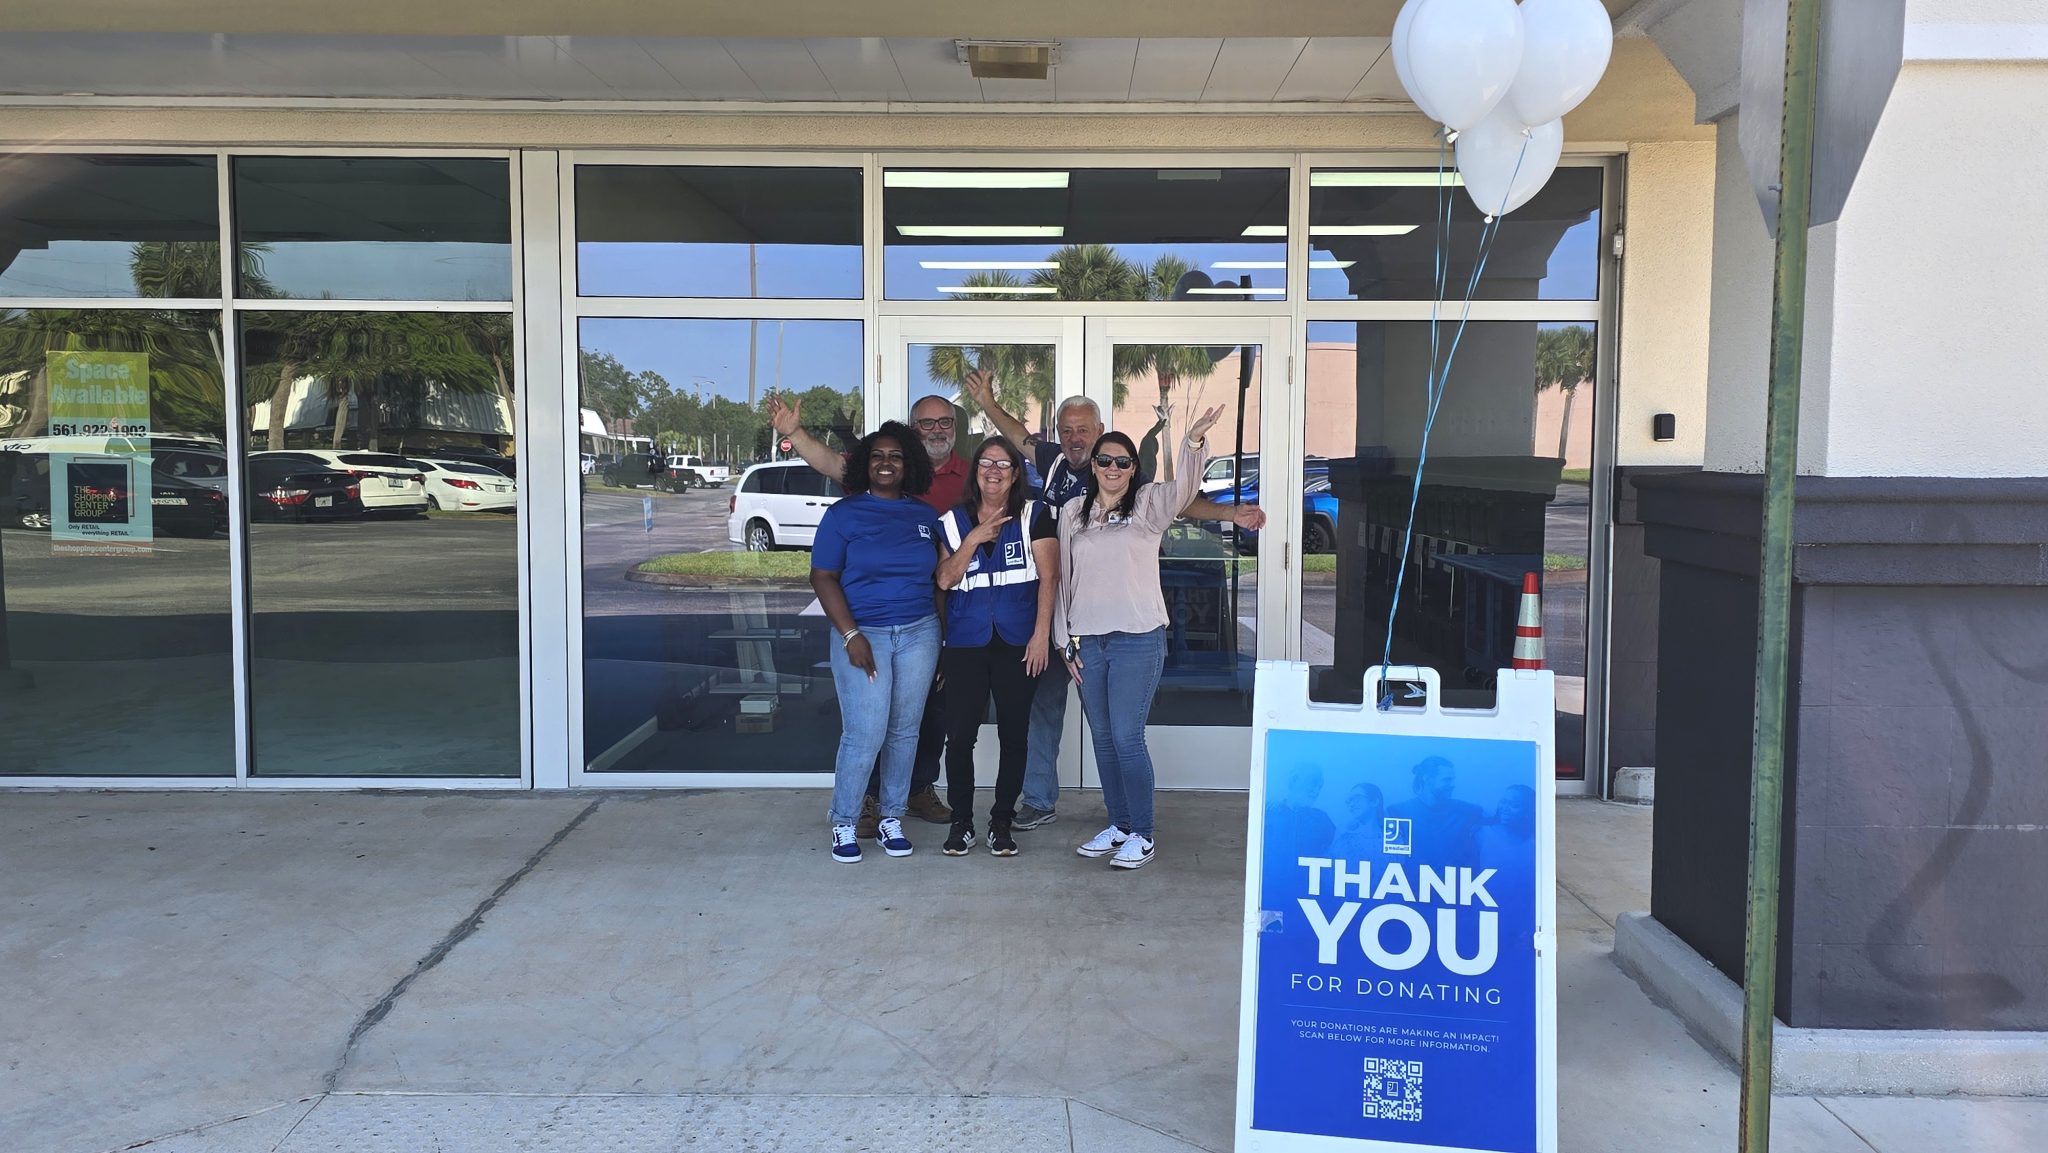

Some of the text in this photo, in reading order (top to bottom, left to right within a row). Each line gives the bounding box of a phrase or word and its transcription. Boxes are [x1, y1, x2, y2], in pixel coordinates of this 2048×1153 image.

[66, 358, 130, 383] Space
[51, 384, 147, 405] Available
[74, 485, 91, 493] THE
[74, 493, 117, 502] SHOPPING
[53, 544, 153, 554] theshoppingcentergroup.com
[1298, 857, 1498, 907] THANK
[1297, 898, 1498, 976] YOU
[1291, 973, 1501, 1005] FOR DONATING
[1291, 1019, 1317, 1028] YOUR
[1320, 1021, 1377, 1033] DONATIONS
[1379, 1027, 1398, 1035] ARE
[1401, 1028, 1440, 1038] MAKING
[1460, 1033, 1500, 1043] IMPACT!
[1299, 1031, 1491, 1053] SCAN BELOW FOR MORE INFORMATION.
